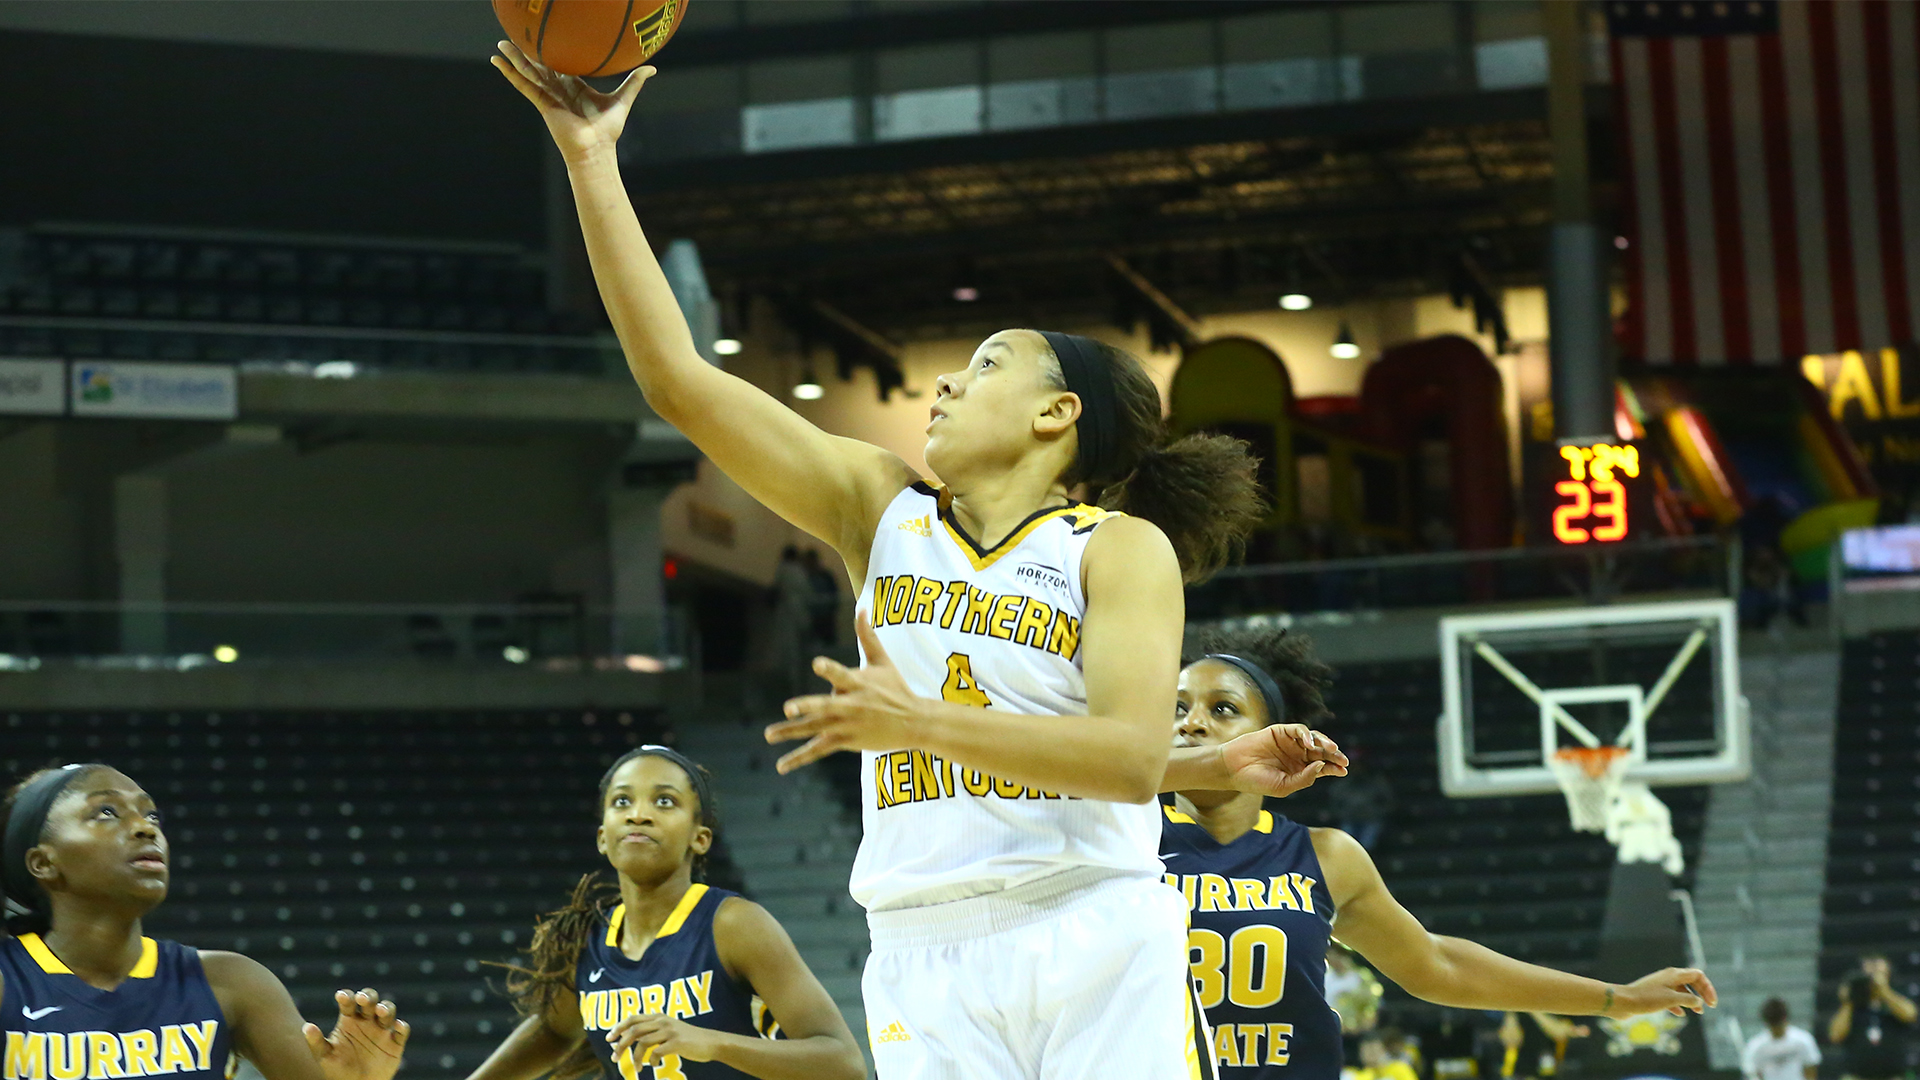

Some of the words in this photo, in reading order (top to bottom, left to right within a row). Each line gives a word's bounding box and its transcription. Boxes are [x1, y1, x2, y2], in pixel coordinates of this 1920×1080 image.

[1560, 443, 1640, 482] 7:24
[897, 523, 933, 538] adidas
[1552, 479, 1629, 544] 23
[1016, 566, 1068, 589] HORIZON
[872, 574, 1081, 663] NORTHERN
[941, 652, 993, 709] 4
[1164, 872, 1317, 915] URRAY
[1188, 924, 1288, 1010] 30
[579, 969, 714, 1032] MURRAY
[3, 1019, 219, 1080] MURRAY
[877, 1032, 911, 1044] adidas
[1209, 1023, 1294, 1068] ATE
